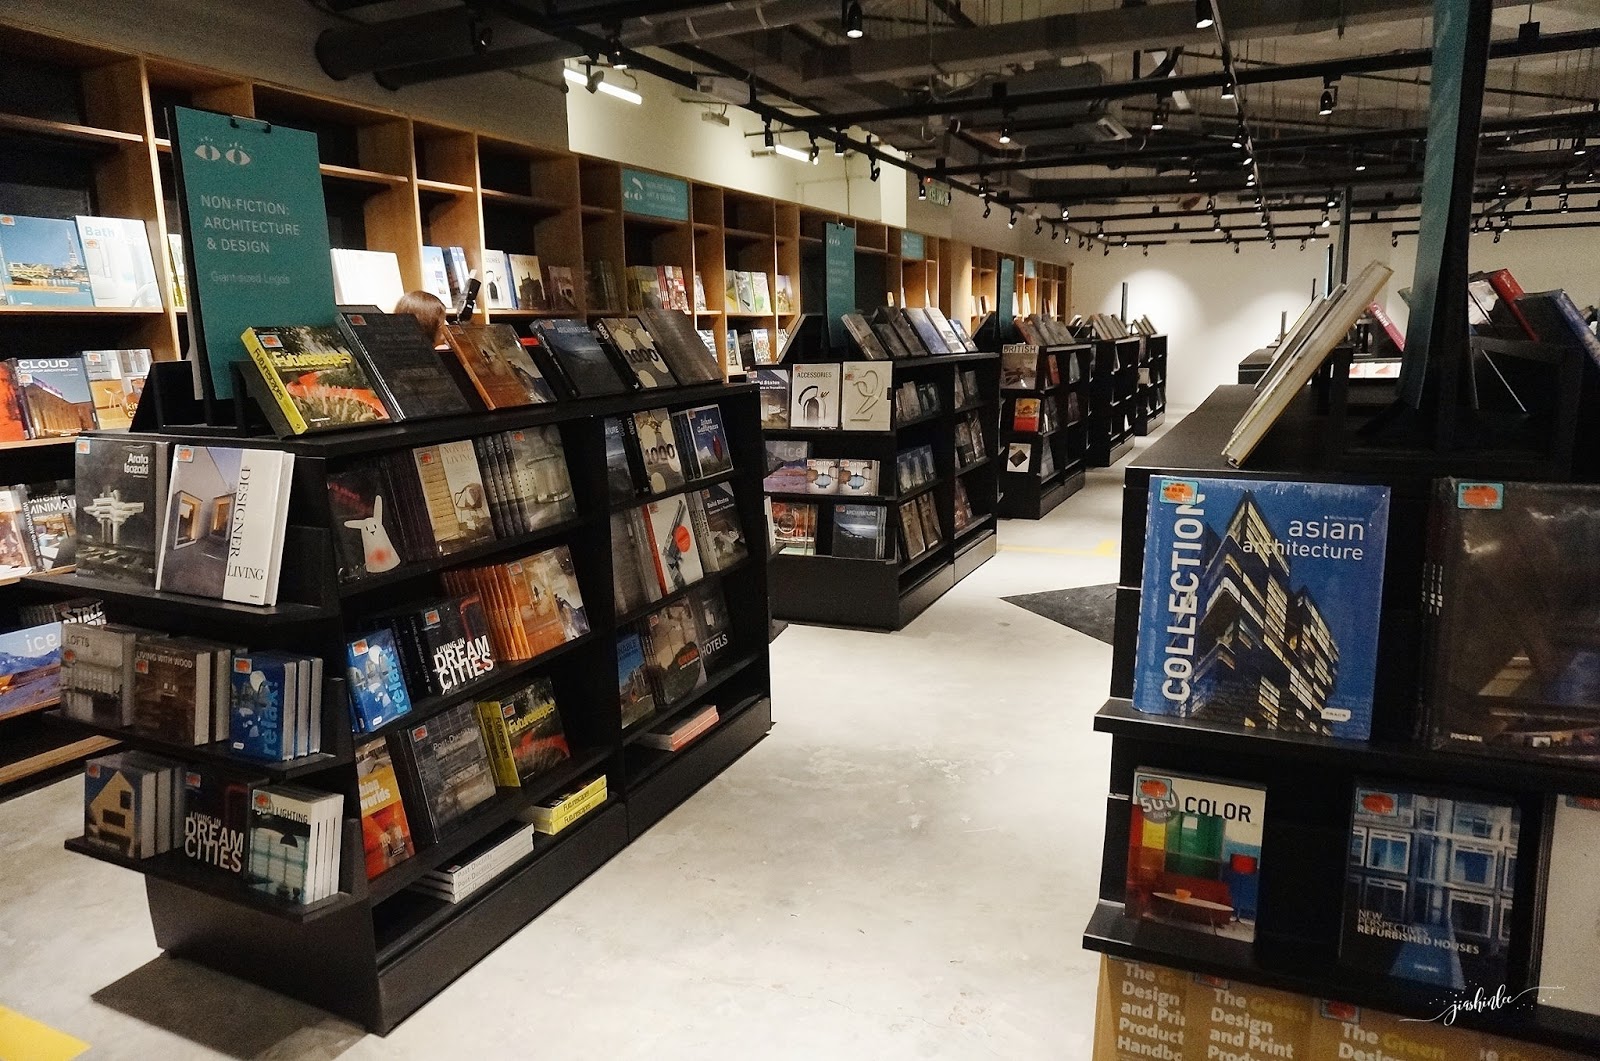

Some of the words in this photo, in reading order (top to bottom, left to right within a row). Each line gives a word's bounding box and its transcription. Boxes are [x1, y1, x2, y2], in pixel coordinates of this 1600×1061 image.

[201, 194, 290, 216] NON-FICTION:
[85, 226, 115, 238] Bath
[204, 216, 301, 237] ARCHITECTURE
[206, 237, 218, 251] &
[221, 238, 271, 254] DESIGN
[597, 322, 610, 340] 1000
[625, 348, 660, 364] 1000
[1003, 345, 1036, 354] BRITISH
[18, 360, 70, 369] CLOUD
[253, 347, 285, 401] Futurescapes
[797, 371, 833, 379] ACCESSORIES
[128, 452, 149, 464] Arata
[645, 443, 676, 466] 1000
[784, 444, 803, 458] ice
[123, 463, 149, 476] Isozaki
[229, 466, 251, 558] DESIGNER
[1288, 515, 1365, 541] asian
[1242, 538, 1364, 561] architecture
[227, 565, 264, 581] LIVING
[1162, 492, 1206, 702] COLLECTION
[25, 634, 58, 653] ice
[67, 634, 90, 648] LOFTS
[436, 641, 457, 655] LIVING
[457, 637, 466, 647] IN
[700, 633, 729, 657] HOTELS
[136, 650, 157, 661] LIVING
[157, 655, 173, 664] WITH
[174, 657, 193, 669] WOOD
[433, 635, 490, 673] DREAM
[439, 651, 494, 690] CITIES
[190, 811, 211, 824] LIVING
[213, 817, 222, 828] IN
[275, 806, 308, 823] LIGHTING
[1184, 796, 1252, 823] COLOR
[185, 816, 244, 854] DREAM
[184, 834, 242, 873] CITIES
[1359, 909, 1383, 920] NEW
[1359, 916, 1430, 937] PERSPECTIVES
[1357, 924, 1432, 946] REFURBISHED
[1434, 938, 1480, 955] HOUSES
[1124, 962, 1156, 982] The
[1121, 980, 1180, 1008] Design
[1213, 987, 1247, 1009] The
[1120, 1000, 1153, 1019] and
[1118, 1016, 1185, 1046] Product
[1210, 1006, 1274, 1035] Design
[1209, 1026, 1246, 1047] and
[1248, 1033, 1294, 1059] Print
[1341, 1021, 1379, 1046] The
